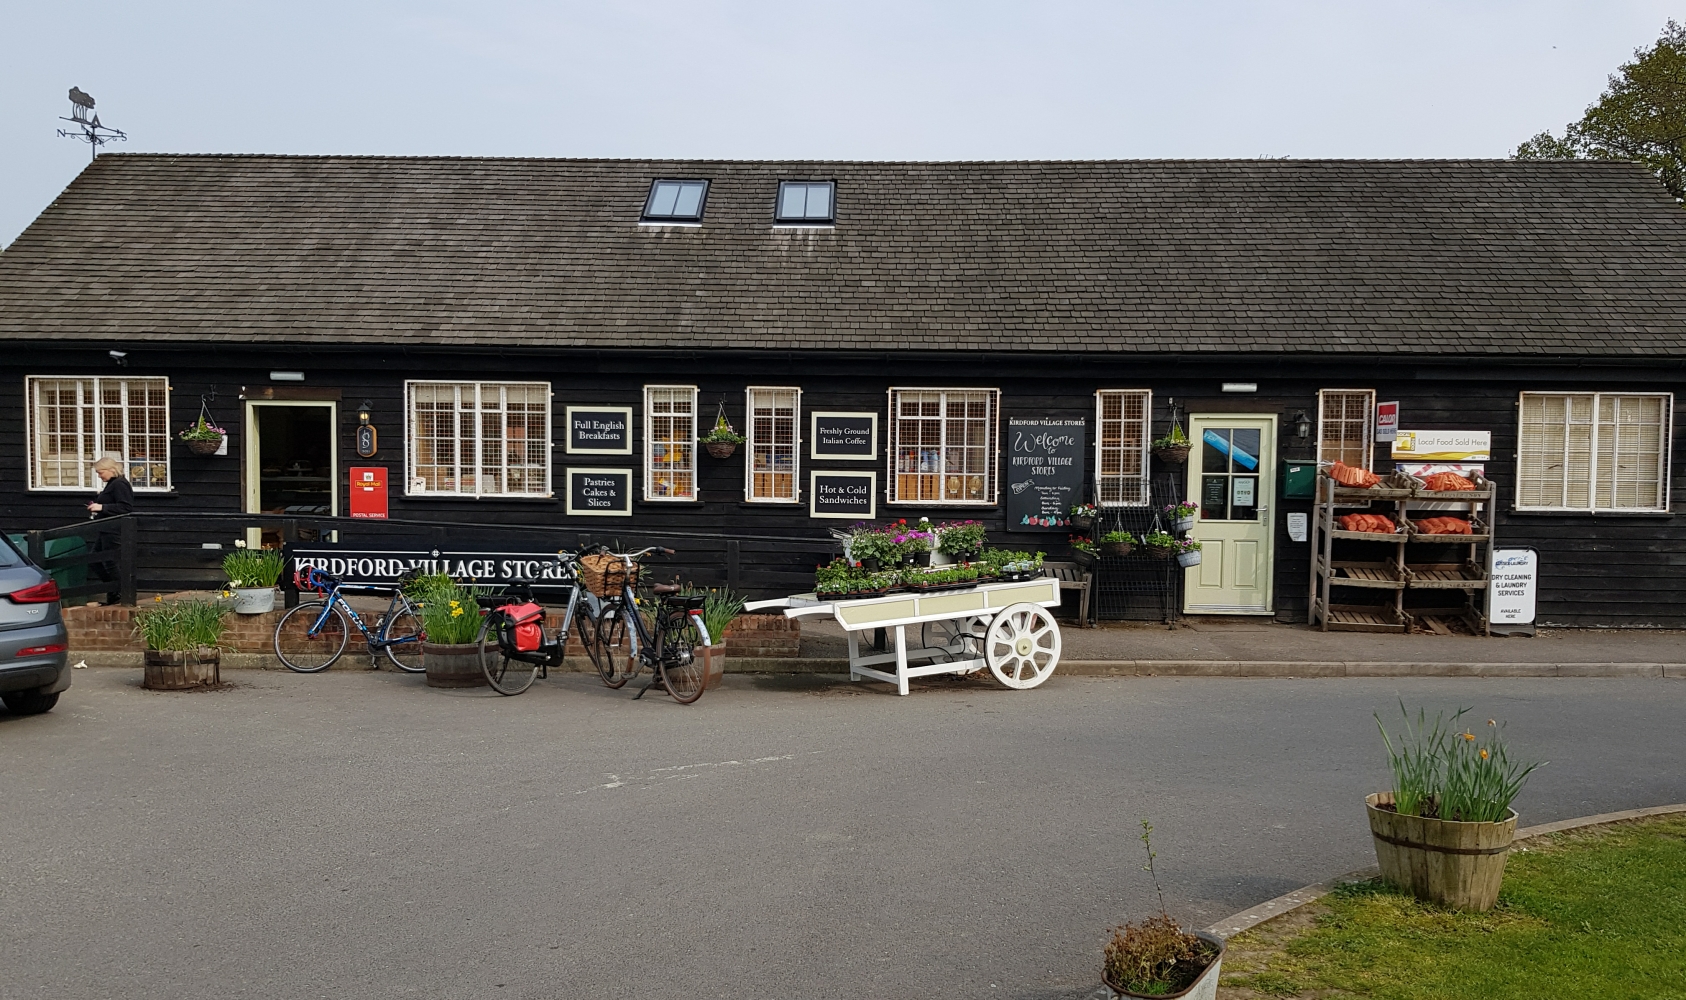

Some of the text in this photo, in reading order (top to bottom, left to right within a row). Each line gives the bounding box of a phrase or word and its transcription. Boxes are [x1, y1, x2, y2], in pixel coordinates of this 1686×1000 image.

[56, 128, 66, 138] N
[1378, 414, 1396, 425] CALOR
[574, 420, 625, 432] Full English
[578, 431, 620, 440] Breakfasts
[819, 427, 870, 436] Freshly Ground
[822, 437, 866, 445] Italian Coffee
[1013, 431, 1076, 453] Welcome
[1418, 438, 1435, 446] Local
[1436, 438, 1453, 446] Food
[1454, 438, 1470, 446] Sold
[1047, 446, 1057, 454] to
[1012, 456, 1073, 467] KIRDFORD VILLAGE
[1031, 466, 1056, 476] STORES
[584, 477, 615, 486] Pastries
[583, 487, 616, 497] Cakes &
[819, 484, 836, 494] Hot
[846, 485, 867, 494] Cold
[587, 498, 612, 507] Slices
[819, 495, 867, 505] Sandwiches
[501, 559, 578, 579] STORES
[337, 598, 363, 631] FOCUS
